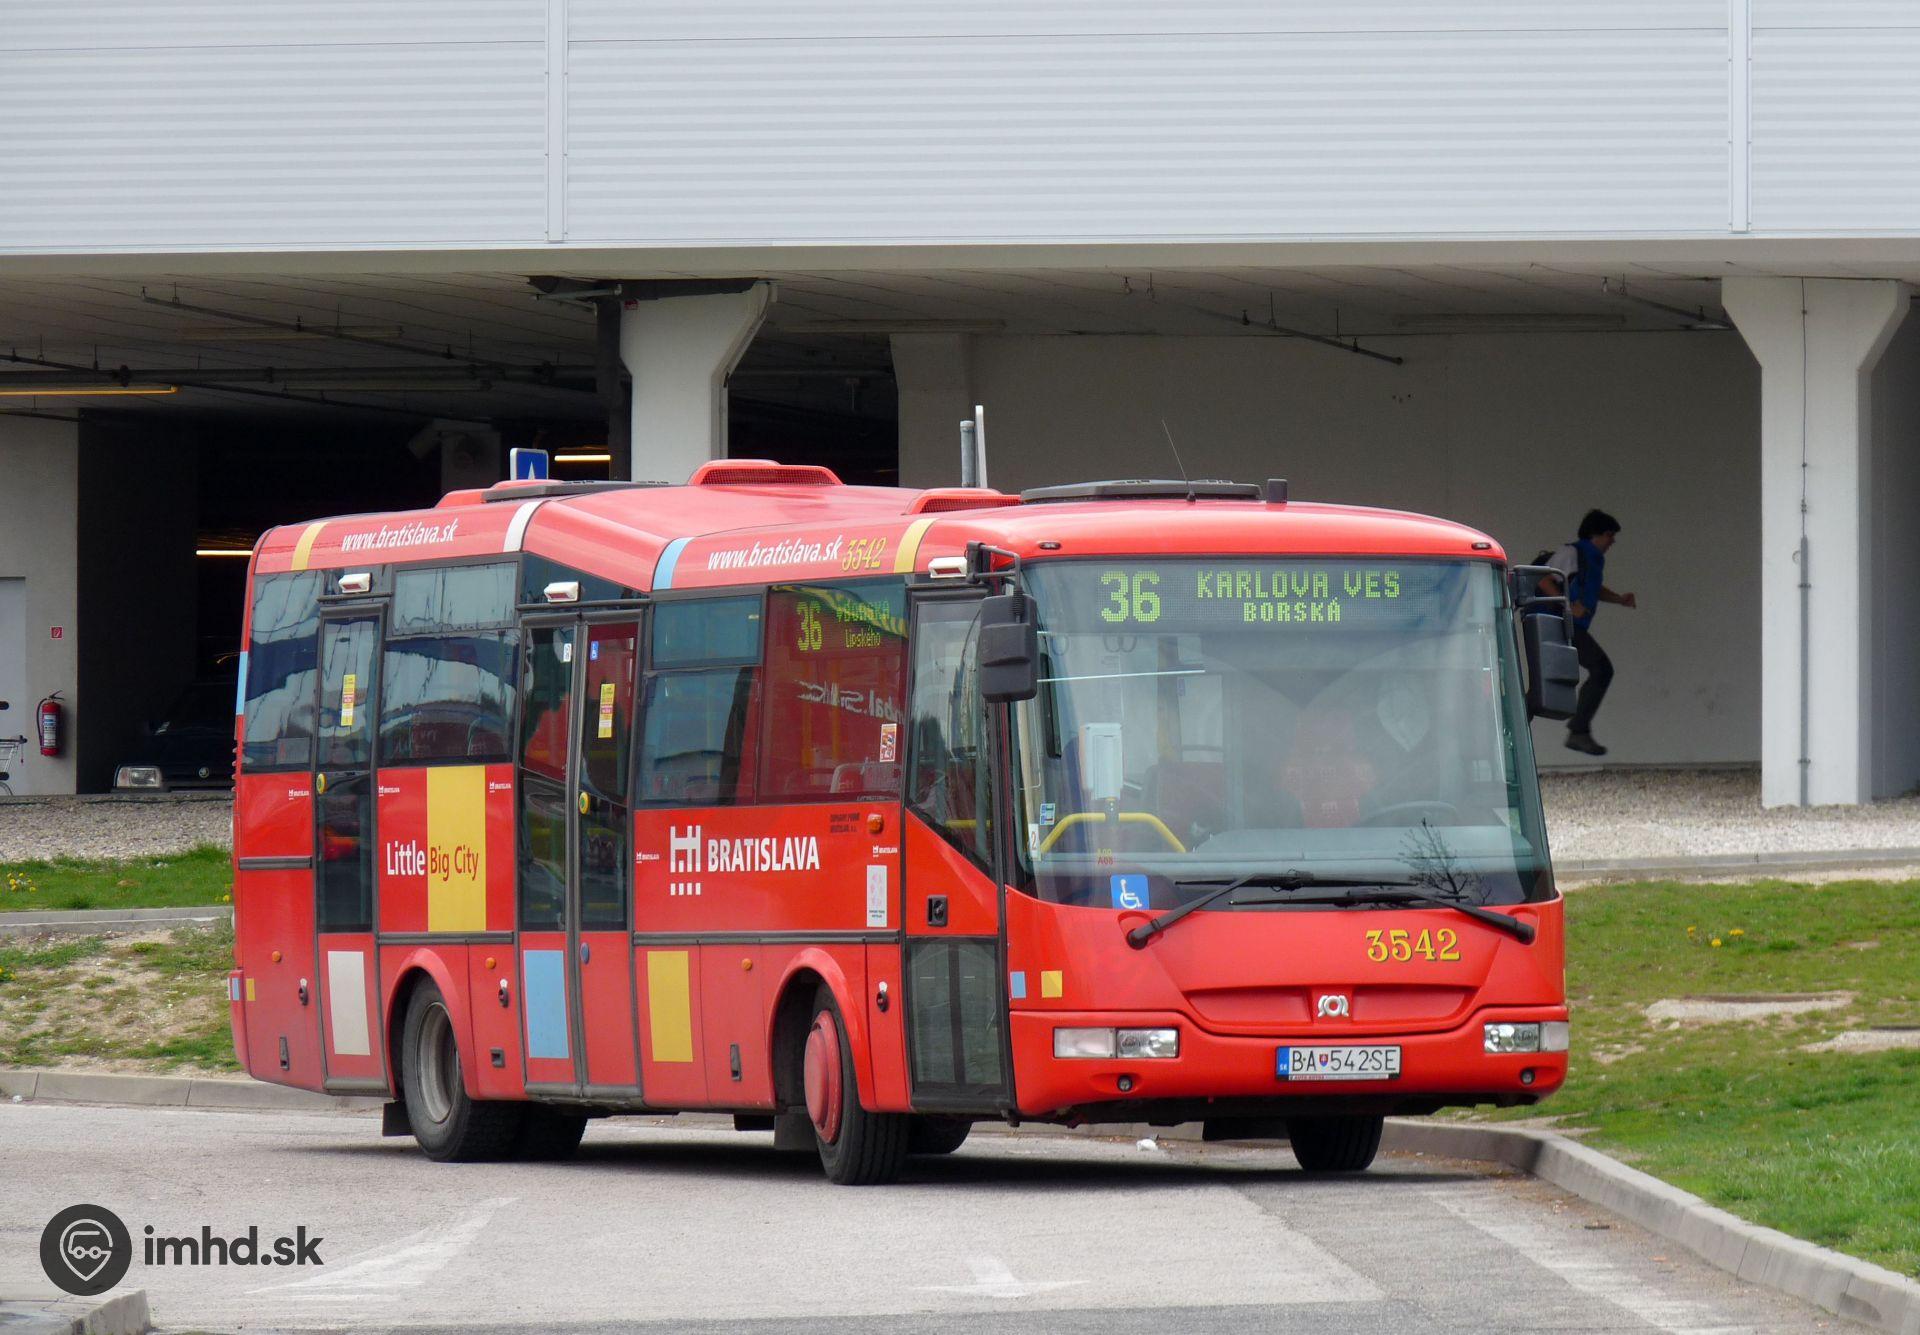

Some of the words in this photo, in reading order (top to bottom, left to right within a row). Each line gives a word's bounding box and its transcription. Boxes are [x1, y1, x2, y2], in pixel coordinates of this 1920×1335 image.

[341, 518, 458, 552] www.bratislava.sk
[708, 535, 843, 570] www.bratislava.sk
[842, 537, 887, 572] 3542
[1101, 571, 1160, 622] 36
[1197, 571, 1329, 598] KARLOVA
[1343, 571, 1400, 598] VES
[796, 600, 823, 652] 36
[1243, 597, 1341, 622] BORSKÁ
[386, 839, 426, 876] Little
[430, 845, 450, 882] Big
[454, 844, 479, 881] City
[707, 836, 820, 873] BRATISLAVA
[1365, 927, 1461, 962] 3542
